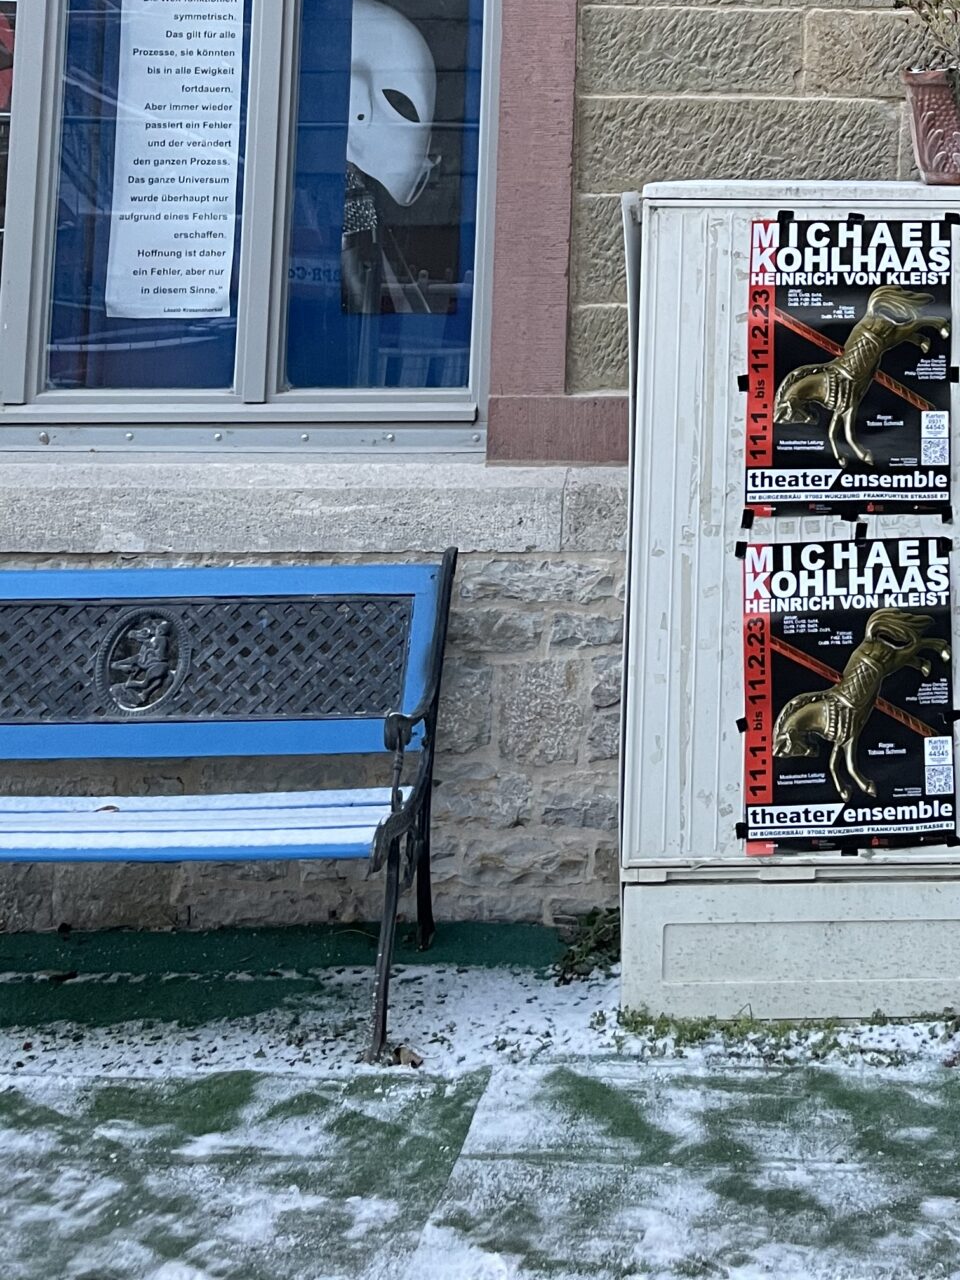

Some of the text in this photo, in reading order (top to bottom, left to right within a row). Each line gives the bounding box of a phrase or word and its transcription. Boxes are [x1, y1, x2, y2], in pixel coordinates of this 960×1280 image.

[174, 13, 236, 21] symmetrisch.
[166, 30, 236, 40] Das gilt für alle
[133, 48, 235, 57] Prozesse, sie könnten
[147, 66, 234, 76] bis in alle Ewigkeit
[182, 84, 233, 93] fortdauern.
[144, 103, 233, 111] Aber immer wieder
[145, 121, 232, 130] passiert ein Fehler
[148, 139, 232, 147] und der verändert
[133, 157, 230, 167] den ganzen Prozess.
[128, 176, 229, 185] Das ganze Universum
[130, 194, 159, 202] wurde
[161, 194, 210, 204] überhaupt
[119, 212, 228, 222] aufgrund eines Fehlers
[752, 223, 950, 247] MICHAEL
[138, 249, 226, 258] Hoffnung ist daher
[752, 247, 950, 272] KOHLHAAS
[133, 268, 147, 276] ein
[151, 268, 182, 276] Fehler,
[185, 267, 206, 276] aber
[751, 272, 949, 285] HEINRICH VON KLEIST
[141, 286, 150, 294] in
[153, 286, 187, 294] diesem
[752, 289, 769, 373] 11.2.23
[755, 379, 764, 398] bis
[750, 471, 947, 488] theater ensemble
[746, 540, 949, 572] MICHAEL
[746, 565, 949, 599] KOHLHAAS
[746, 591, 949, 613] HEINRICH VON KLEIST
[748, 617, 766, 704] 11.2.23
[754, 711, 763, 731] bis
[751, 801, 952, 824] theater ensemble
